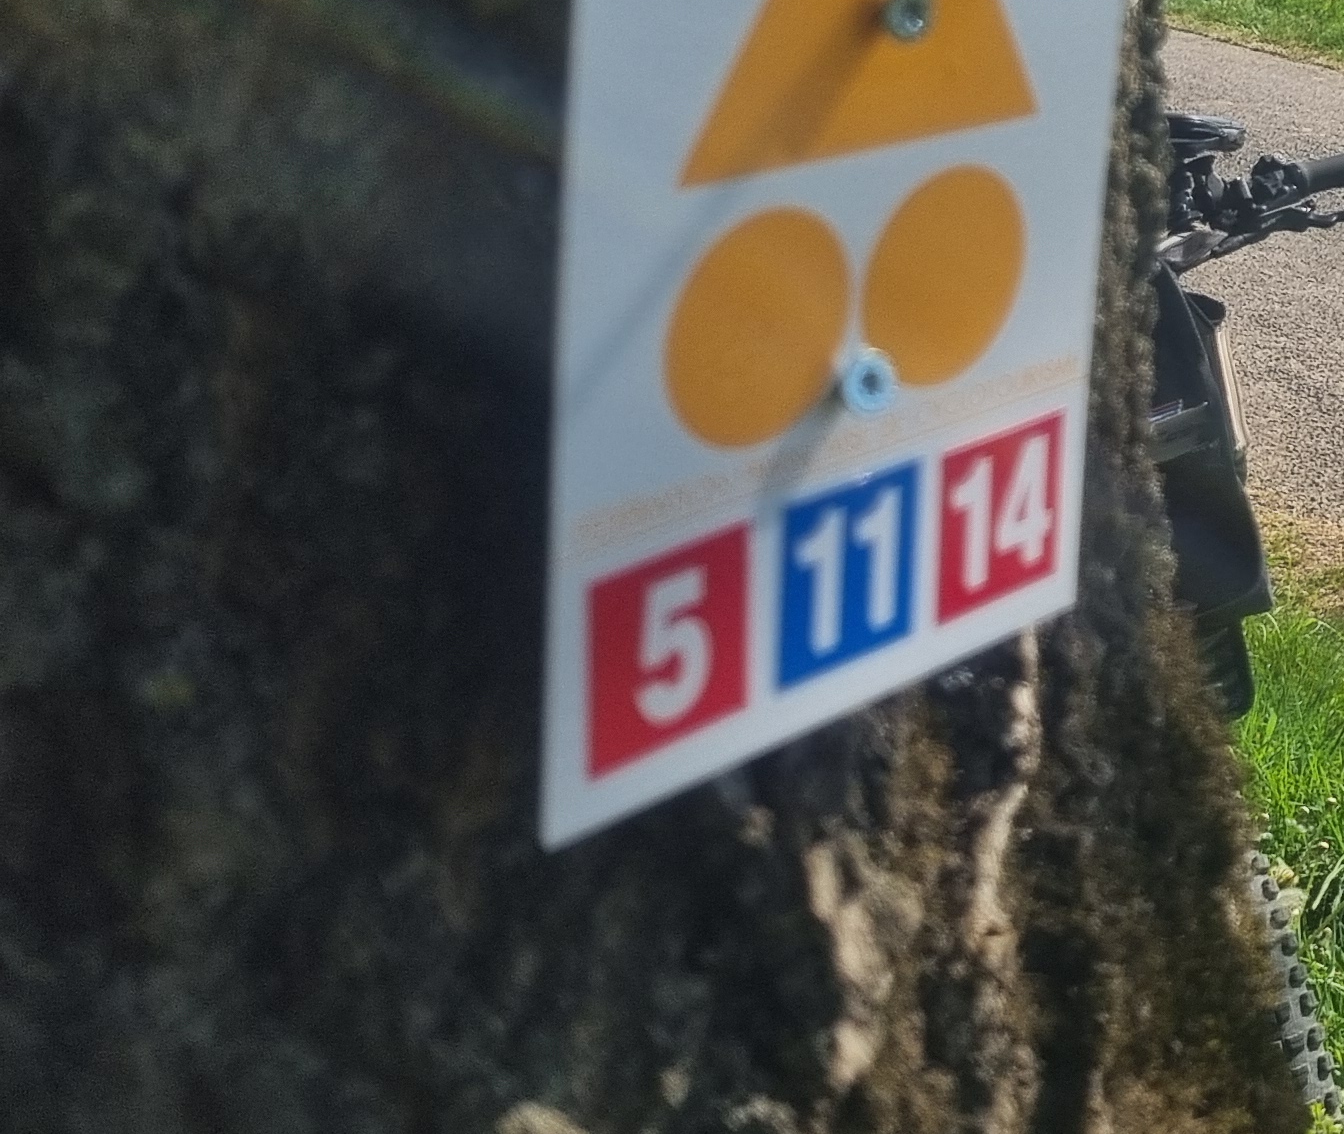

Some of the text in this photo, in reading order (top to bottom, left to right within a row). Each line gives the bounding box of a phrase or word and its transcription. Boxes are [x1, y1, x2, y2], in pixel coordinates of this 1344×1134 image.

[636, 567, 715, 725] 5
[795, 483, 901, 654] 11
[950, 431, 1054, 592] 14
